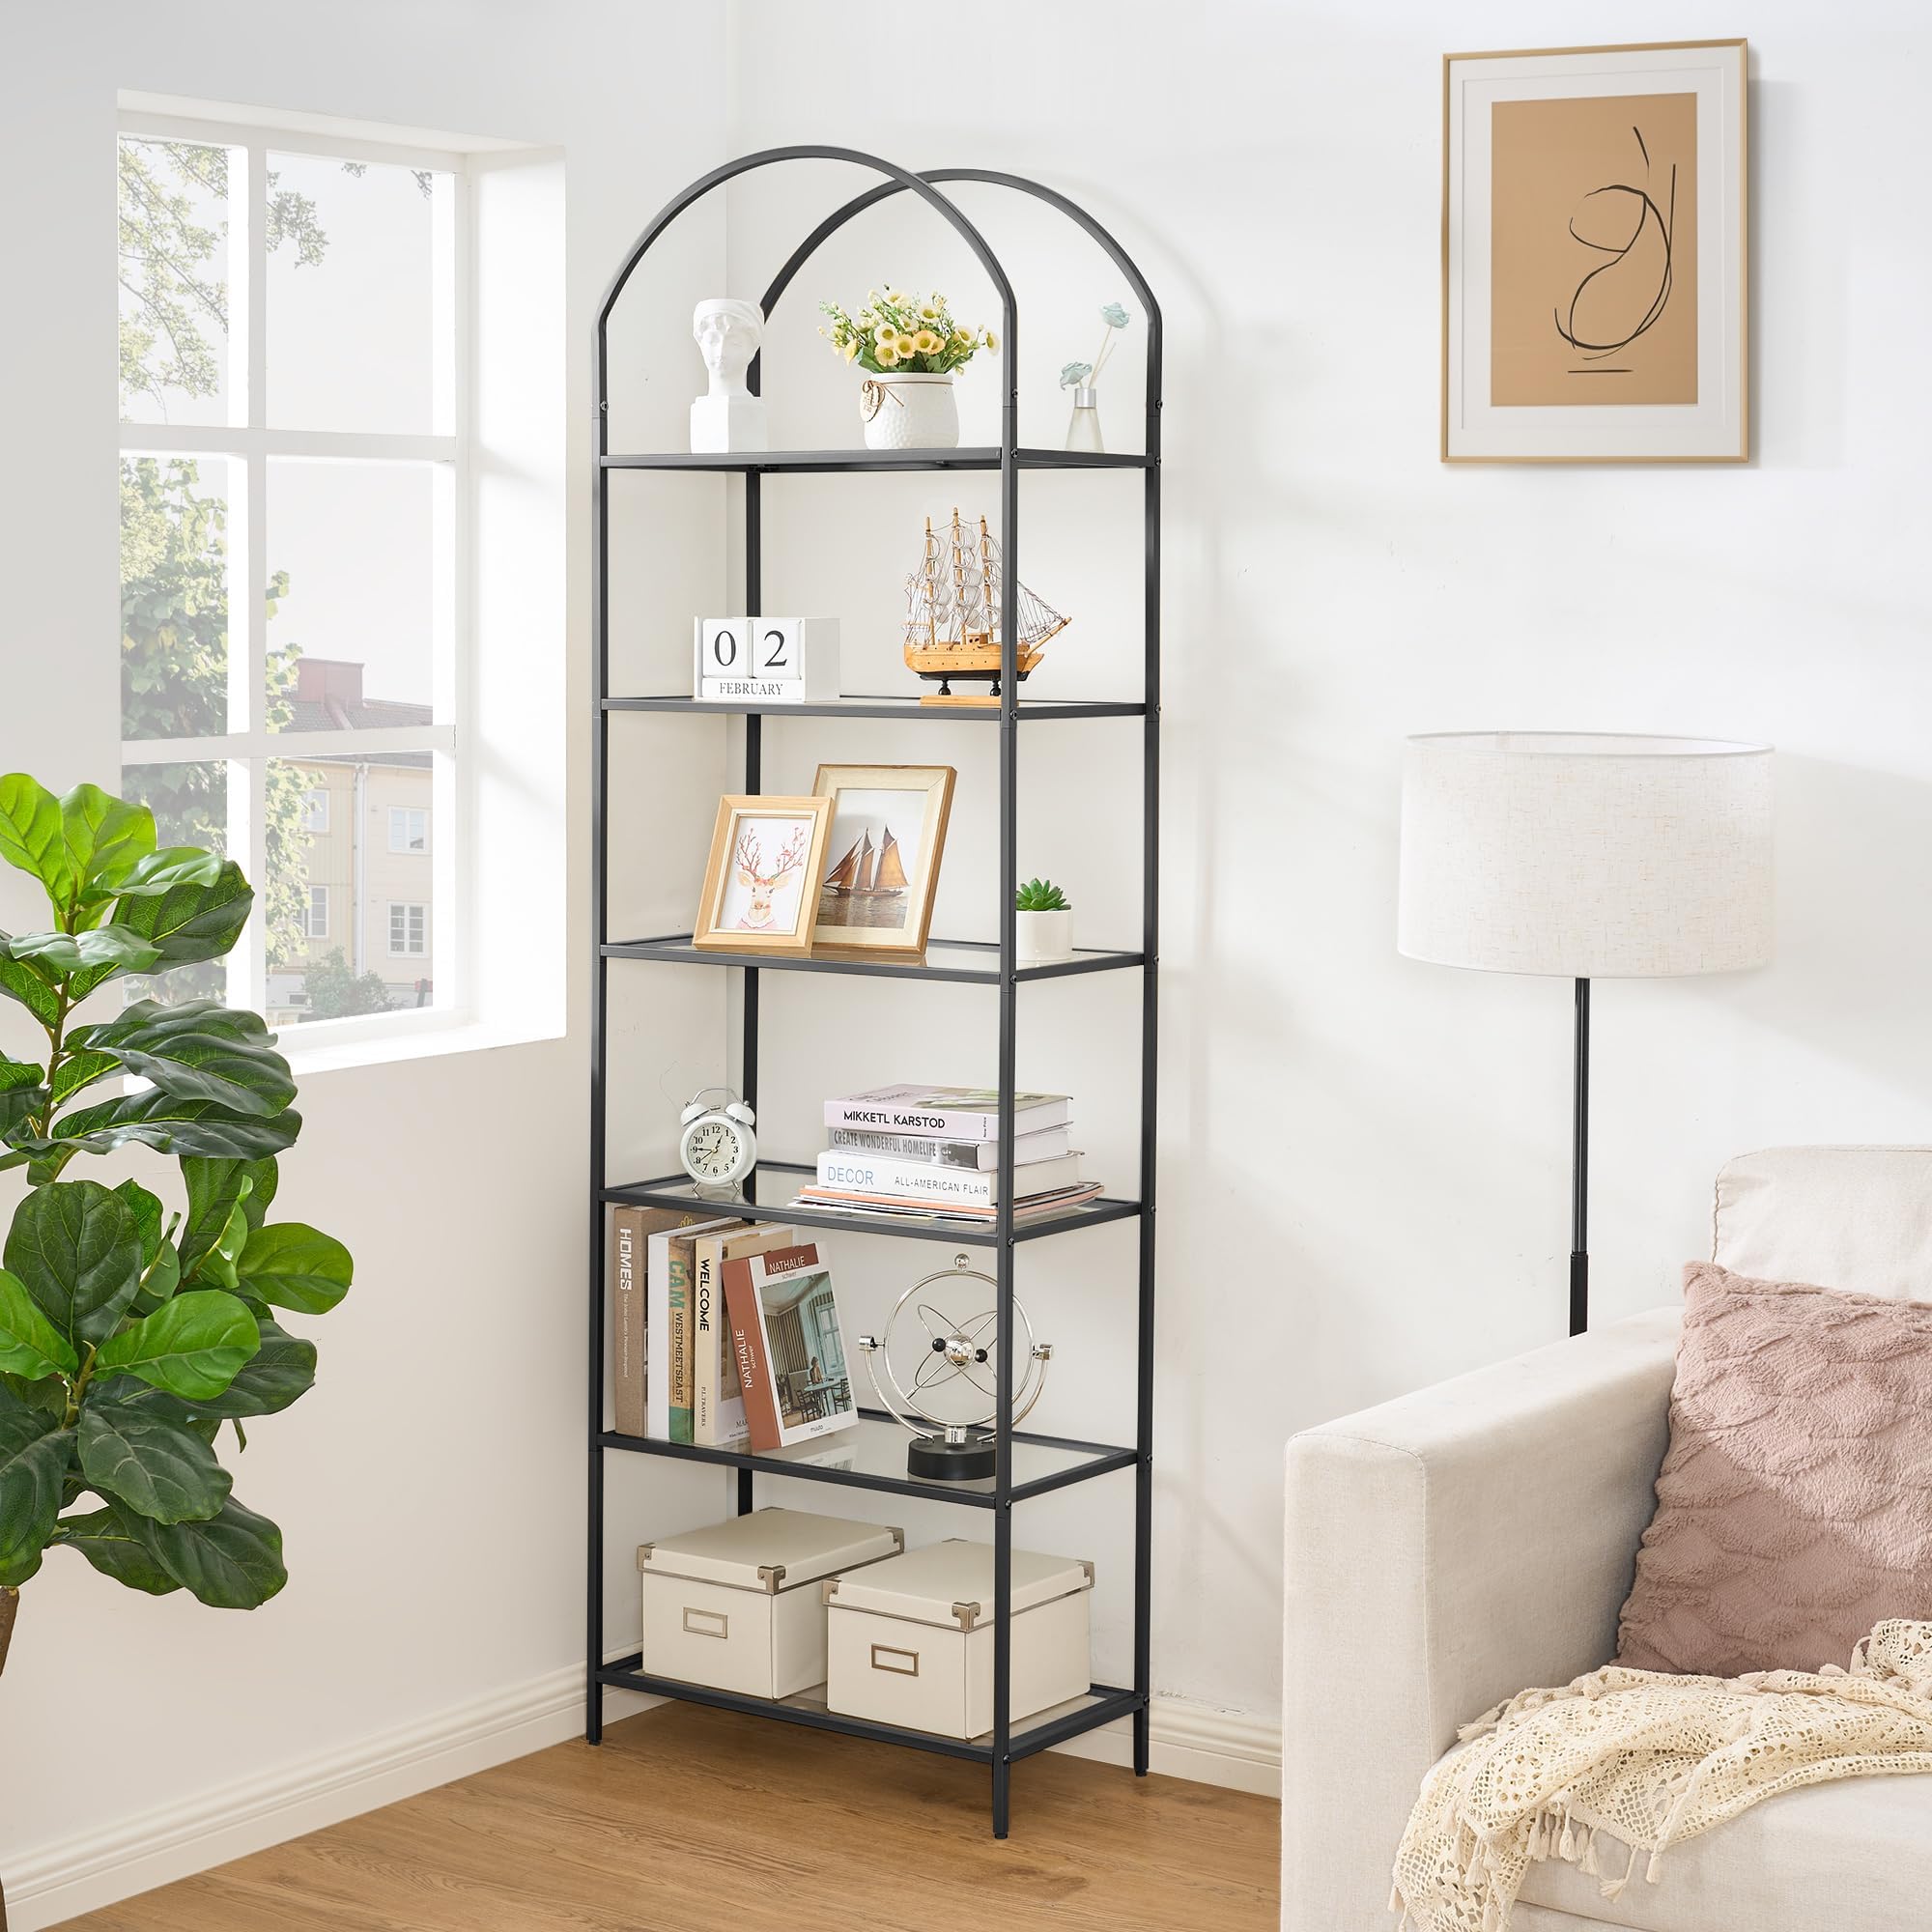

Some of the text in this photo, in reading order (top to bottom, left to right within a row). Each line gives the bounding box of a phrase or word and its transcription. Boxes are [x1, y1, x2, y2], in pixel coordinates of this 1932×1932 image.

[714, 630, 788, 667] 0 2
[720, 682, 783, 696] FEBRUARY
[843, 1110, 946, 1129] MIKKETL KARSTOD
[834, 1129, 937, 1157] CREATE WONDERFUL HOMELIFE
[828, 1166, 989, 1196] DECOR ALL-AMERICAN FLAIR
[619, 1228, 633, 1291] HOMES
[769, 1255, 807, 1274] NATHALIE
[668, 1260, 685, 1309] CAM
[699, 1258, 711, 1332] WELCOME
[735, 1328, 753, 1388] NATHALIE
